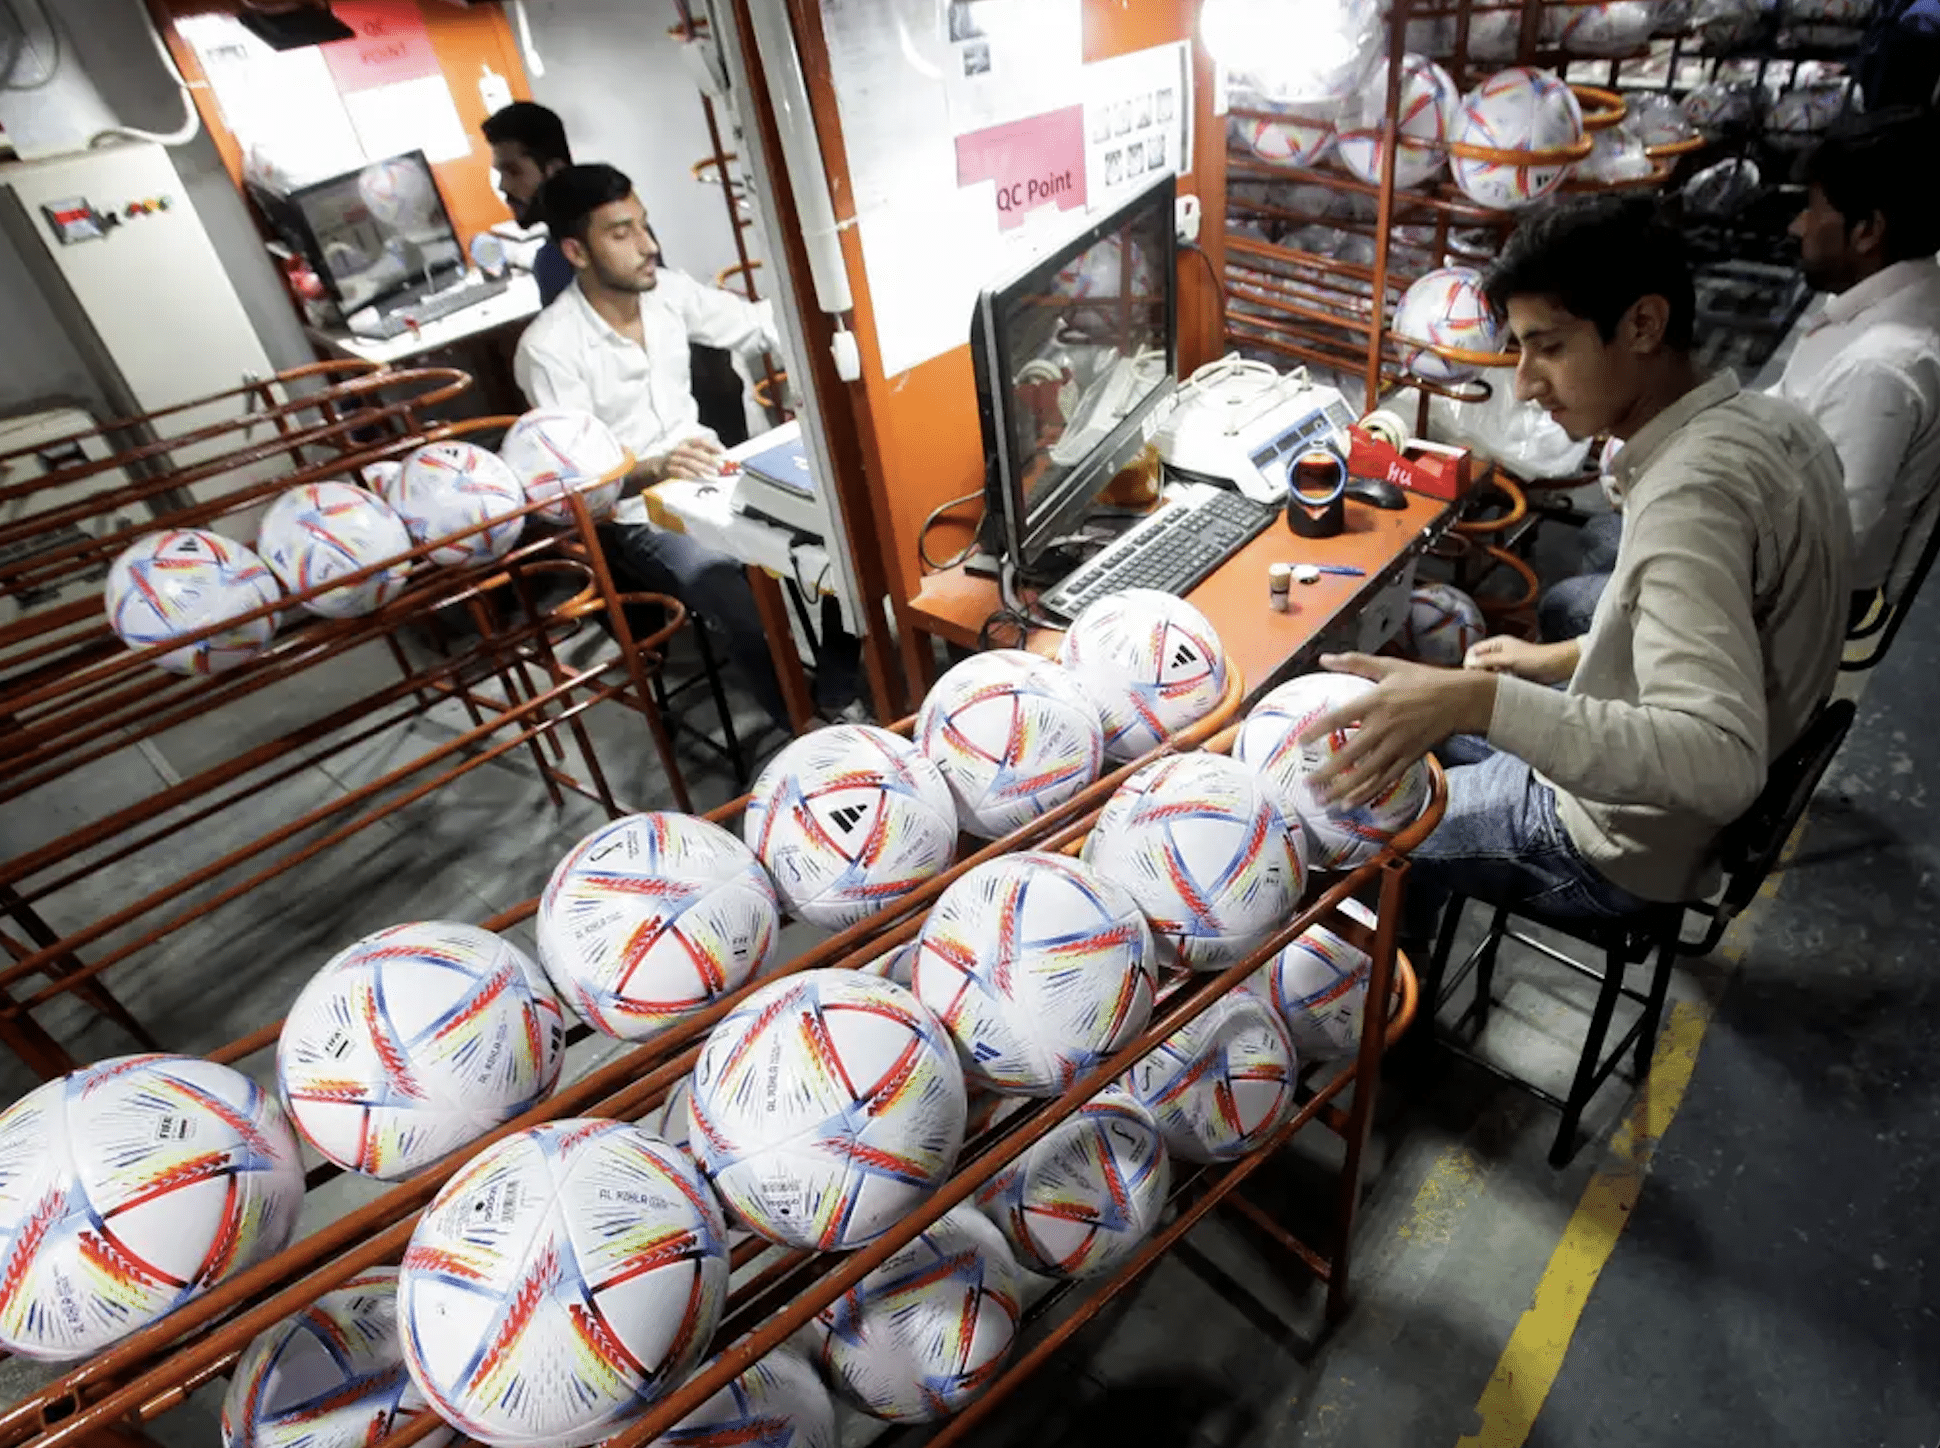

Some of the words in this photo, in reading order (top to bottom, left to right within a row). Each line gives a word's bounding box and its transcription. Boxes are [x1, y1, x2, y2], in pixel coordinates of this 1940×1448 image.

[997, 183, 1021, 211] QC
[1028, 170, 1072, 201] Point
[325, 1032, 341, 1051] FIFA
